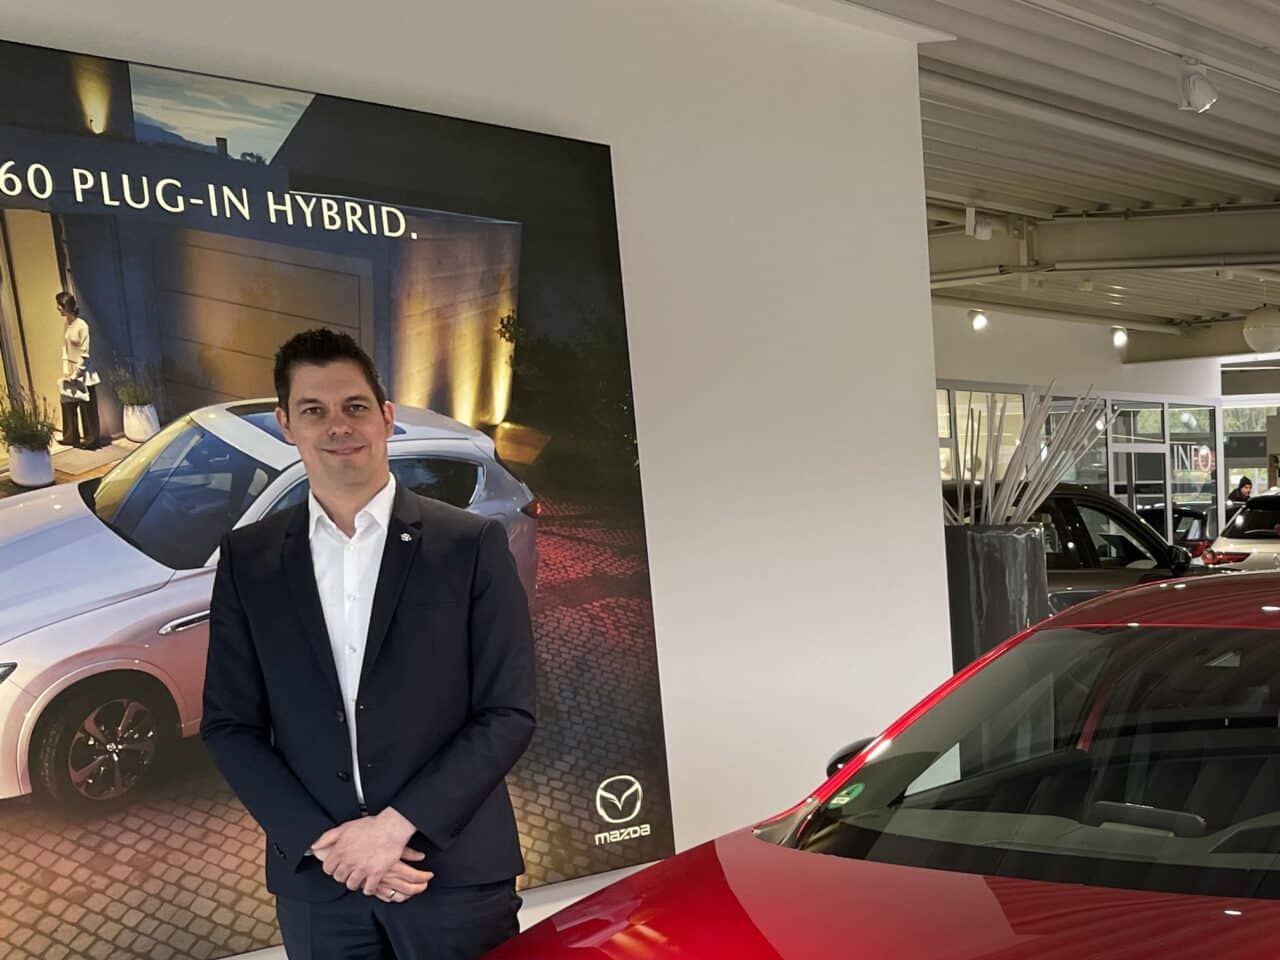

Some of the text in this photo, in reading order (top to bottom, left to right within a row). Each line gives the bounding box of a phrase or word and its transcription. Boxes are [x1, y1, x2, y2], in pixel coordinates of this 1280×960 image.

[73, 168, 251, 222] PLUG-IN
[267, 192, 418, 240] HYBRID.
[1173, 444, 1212, 473] INFO
